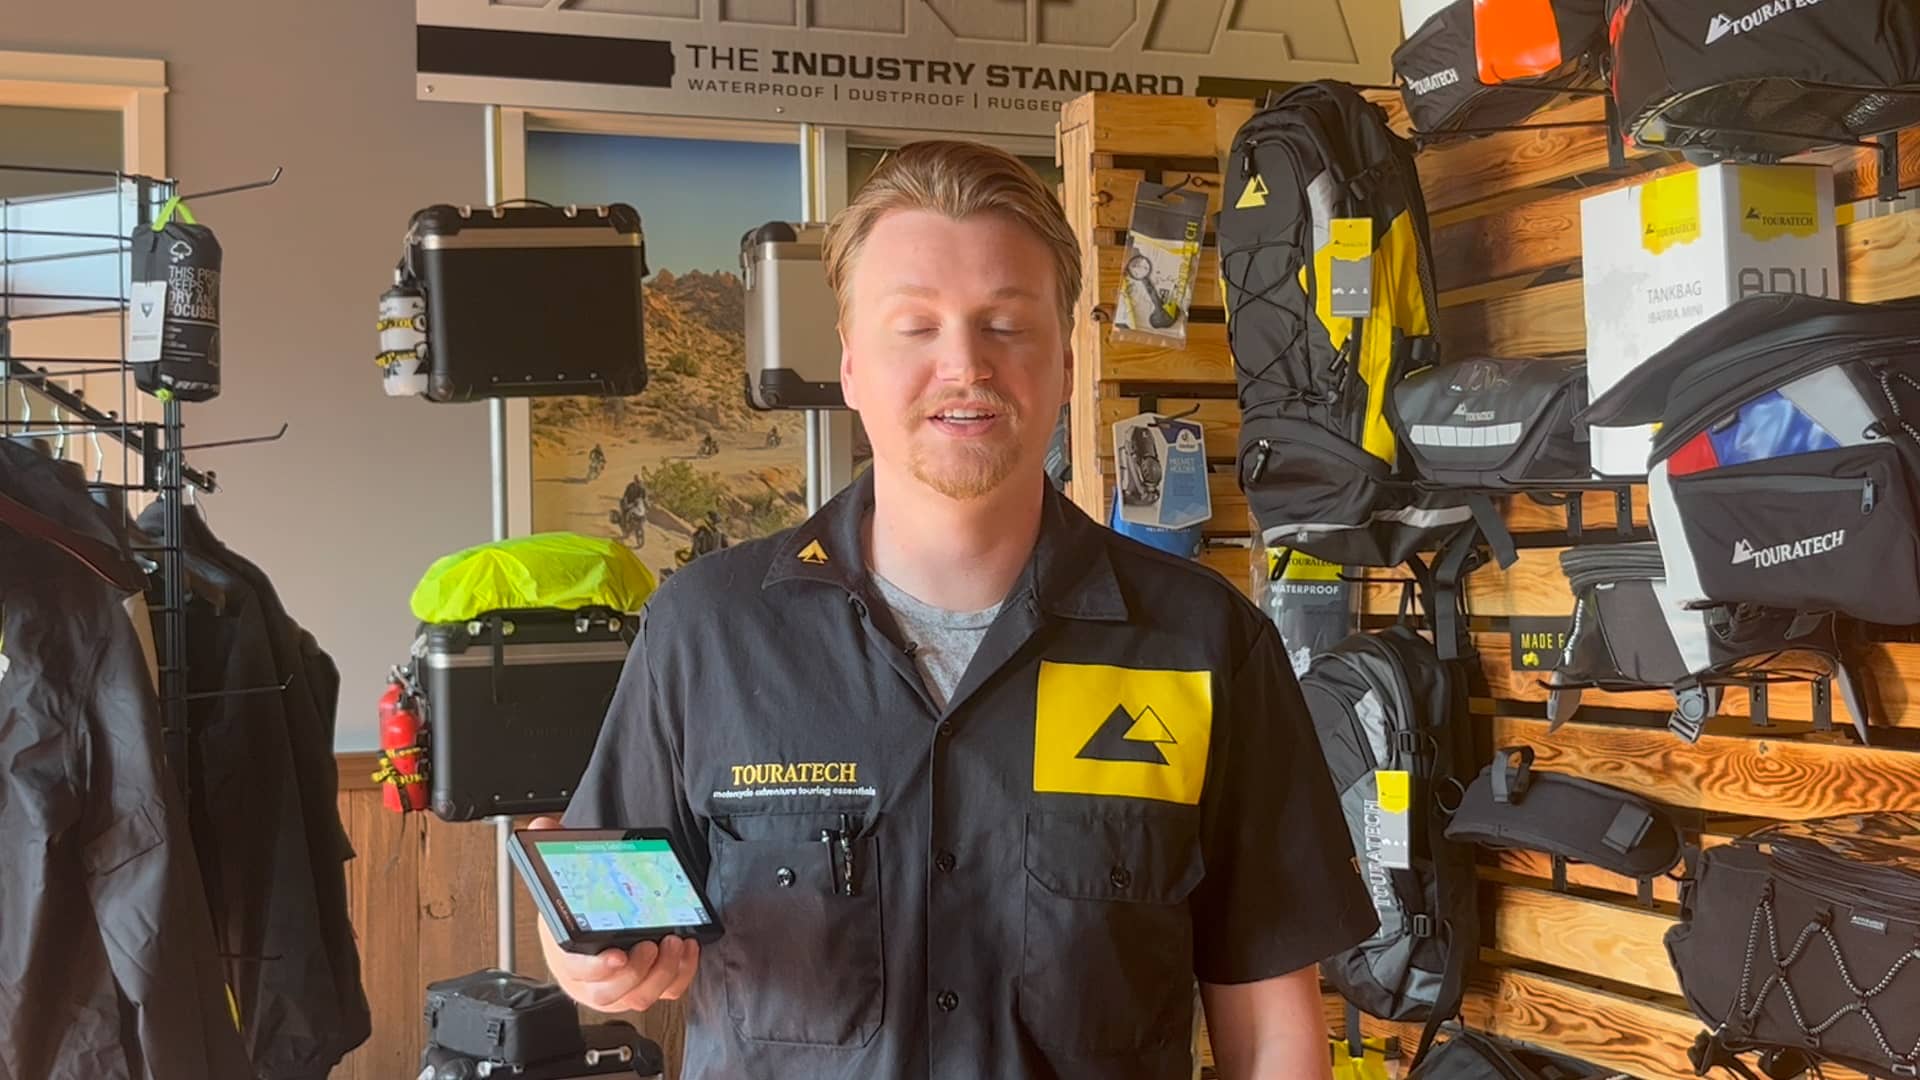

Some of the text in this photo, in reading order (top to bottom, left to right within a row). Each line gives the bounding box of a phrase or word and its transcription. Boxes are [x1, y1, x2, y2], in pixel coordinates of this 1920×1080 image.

[1730, 0, 1817, 35] TOURATE
[685, 43, 1184, 96] THE INDUSTRY STANDARD
[1413, 67, 1459, 96] TOURATECH
[687, 78, 1063, 113] WATERPROOF DUSTPROOF RUGGED
[1761, 215, 1814, 227] TOURATECH
[168, 264, 194, 280] THIS
[168, 279, 205, 292] KEEPS
[168, 290, 193, 304] DRY
[1647, 280, 1703, 304] TANKBAG
[1751, 528, 1846, 569] TOURATECH
[1270, 583, 1340, 595] WATERPROOF
[1521, 632, 1554, 650] MADE
[731, 761, 858, 787] TOURATECH
[798, 784, 831, 797] touring
[832, 784, 876, 797] essentials
[1363, 799, 1391, 907] TOURATECH
